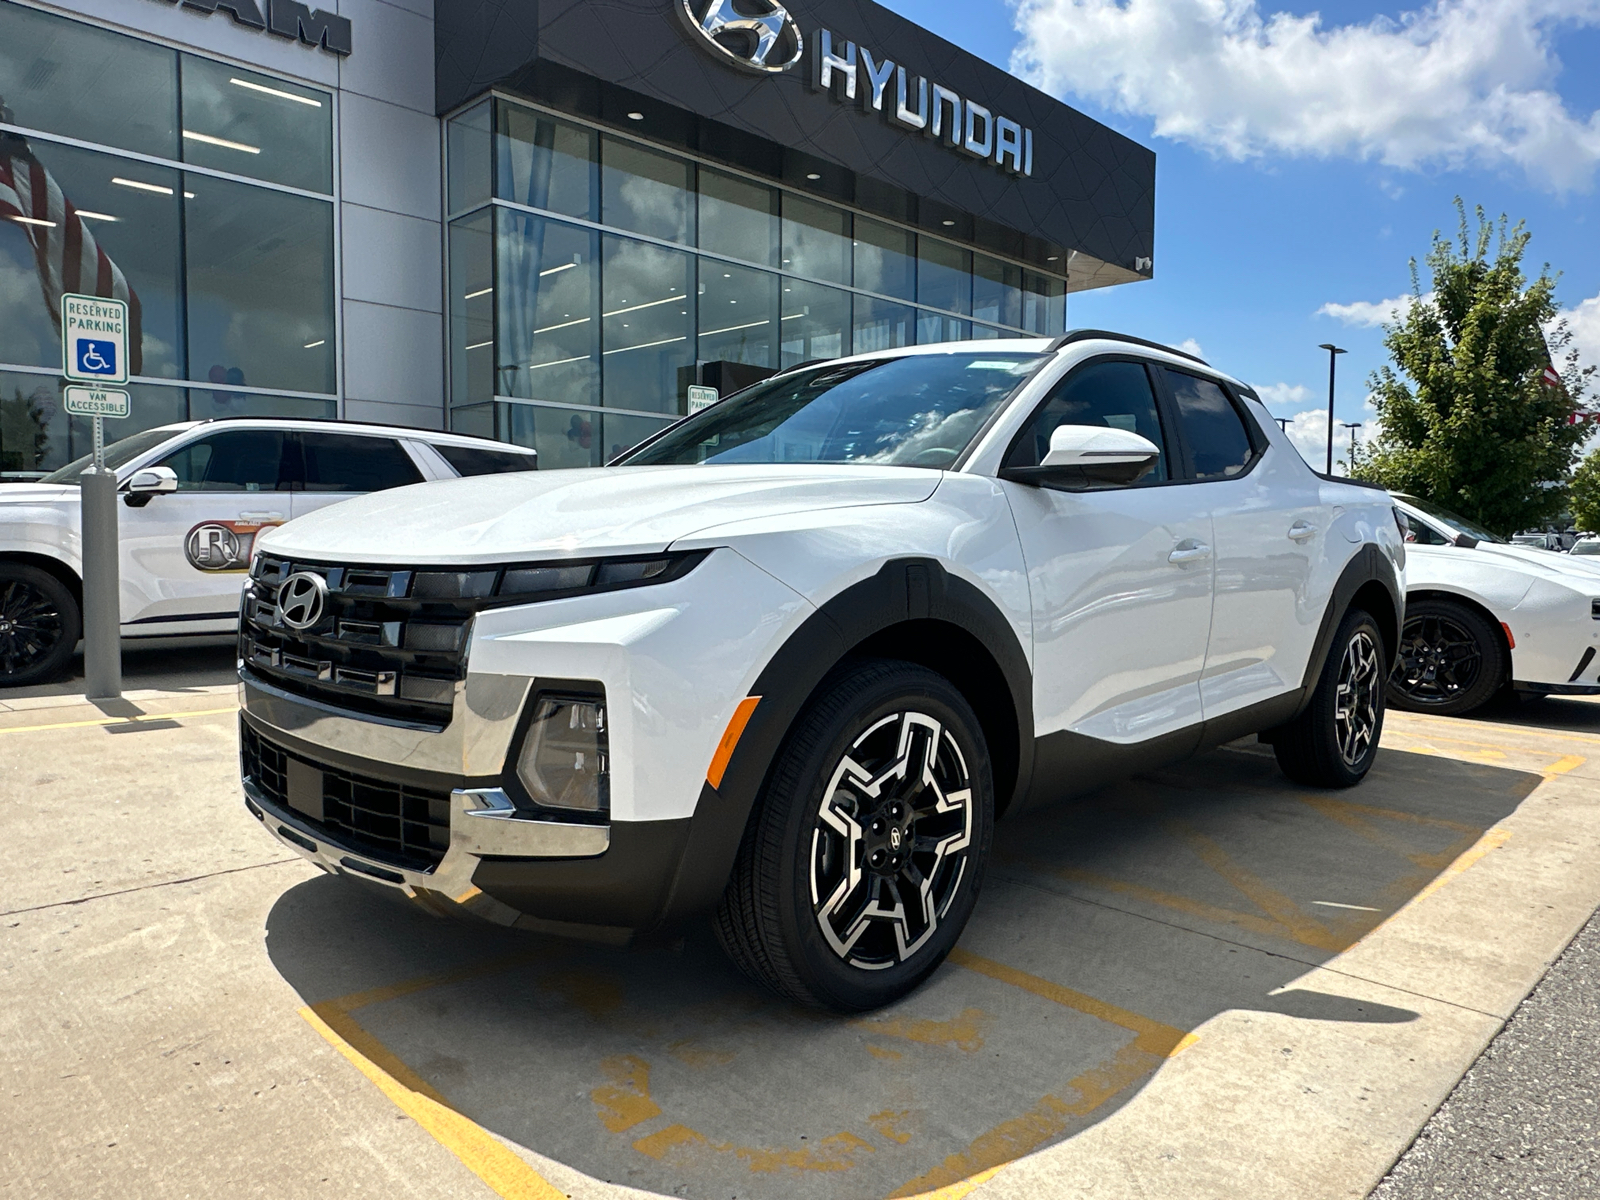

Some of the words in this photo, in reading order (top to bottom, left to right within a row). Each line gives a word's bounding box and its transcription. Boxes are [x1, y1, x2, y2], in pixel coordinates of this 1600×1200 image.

[813, 28, 1033, 177] HYUNDAI
[69, 303, 121, 319] RESERVED
[69, 317, 122, 334] PARKING
[89, 392, 107, 401] VAN
[692, 391, 715, 401] RESERVED
[70, 401, 125, 413] ACCESSIBLE
